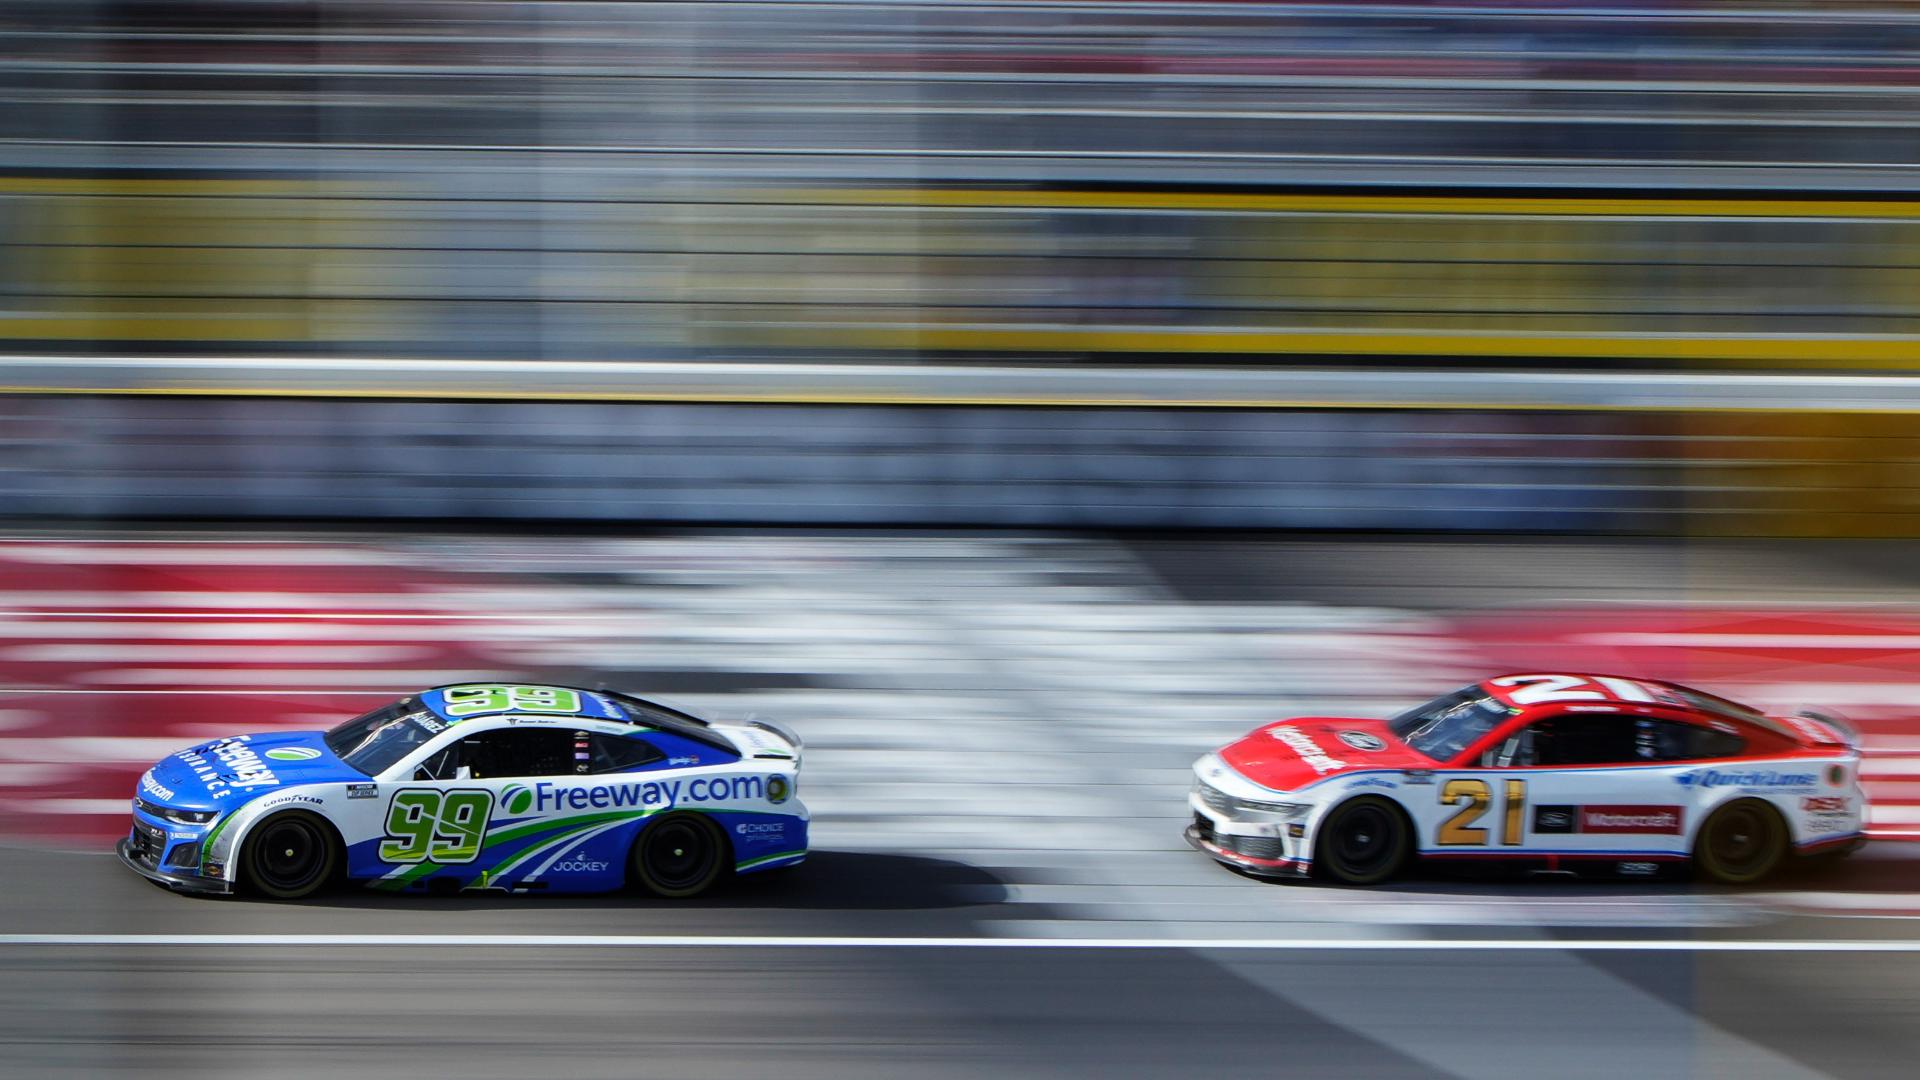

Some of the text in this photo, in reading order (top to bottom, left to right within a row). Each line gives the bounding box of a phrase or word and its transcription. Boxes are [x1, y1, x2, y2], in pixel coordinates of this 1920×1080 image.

[442, 685, 581, 716] 99
[1490, 675, 1656, 704] 21
[536, 774, 763, 812] Freeway.com
[379, 788, 495, 864] 99
[1434, 777, 1527, 847] 21
[553, 861, 609, 872] JOCKEY
